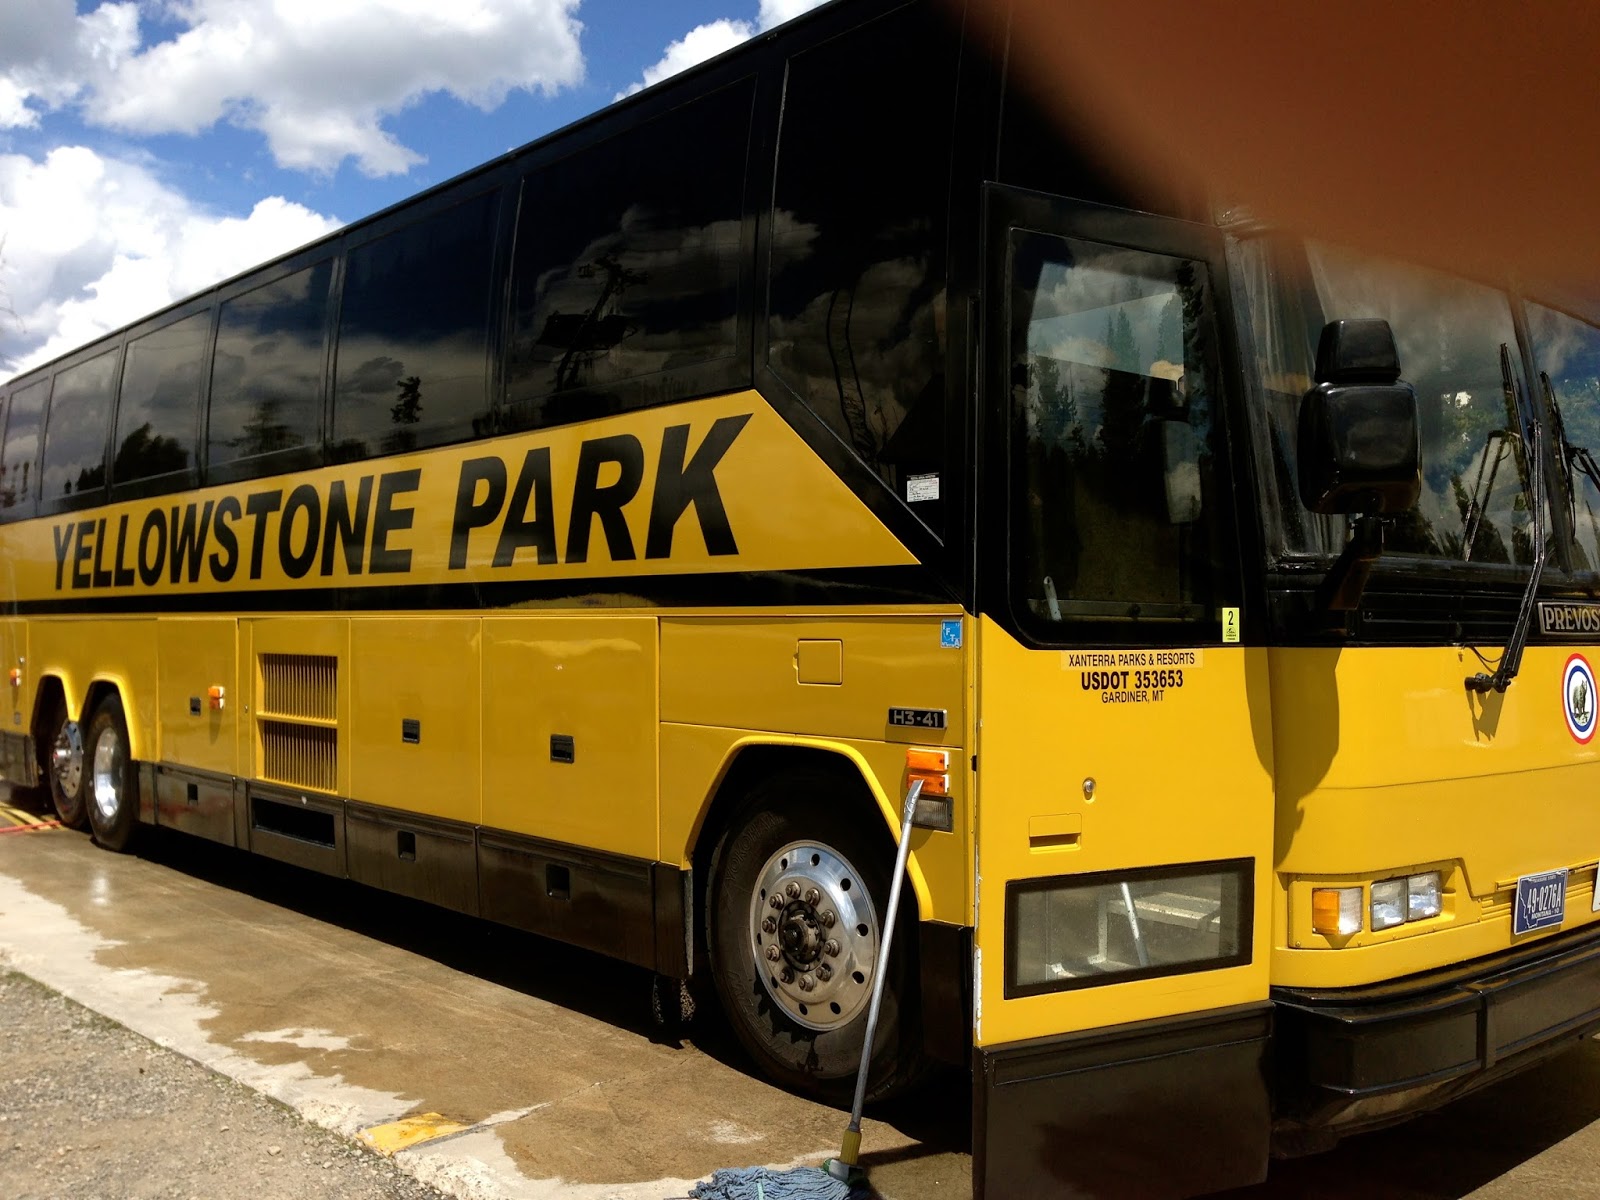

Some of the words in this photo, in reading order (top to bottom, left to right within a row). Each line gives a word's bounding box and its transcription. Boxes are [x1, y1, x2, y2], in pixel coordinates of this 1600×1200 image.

[53, 468, 422, 590] YELLOWSTONE
[448, 413, 754, 570] PARK
[1228, 610, 1234, 626] 2
[1069, 654, 1116, 667] XANTERRA
[1118, 653, 1147, 667] PARKS
[1148, 653, 1155, 666] &
[1156, 652, 1195, 665] RESORTS
[1081, 671, 1130, 690] USDOT
[1134, 669, 1184, 689] 353653
[1101, 690, 1150, 704] GARDINER,
[1152, 689, 1165, 702] MT
